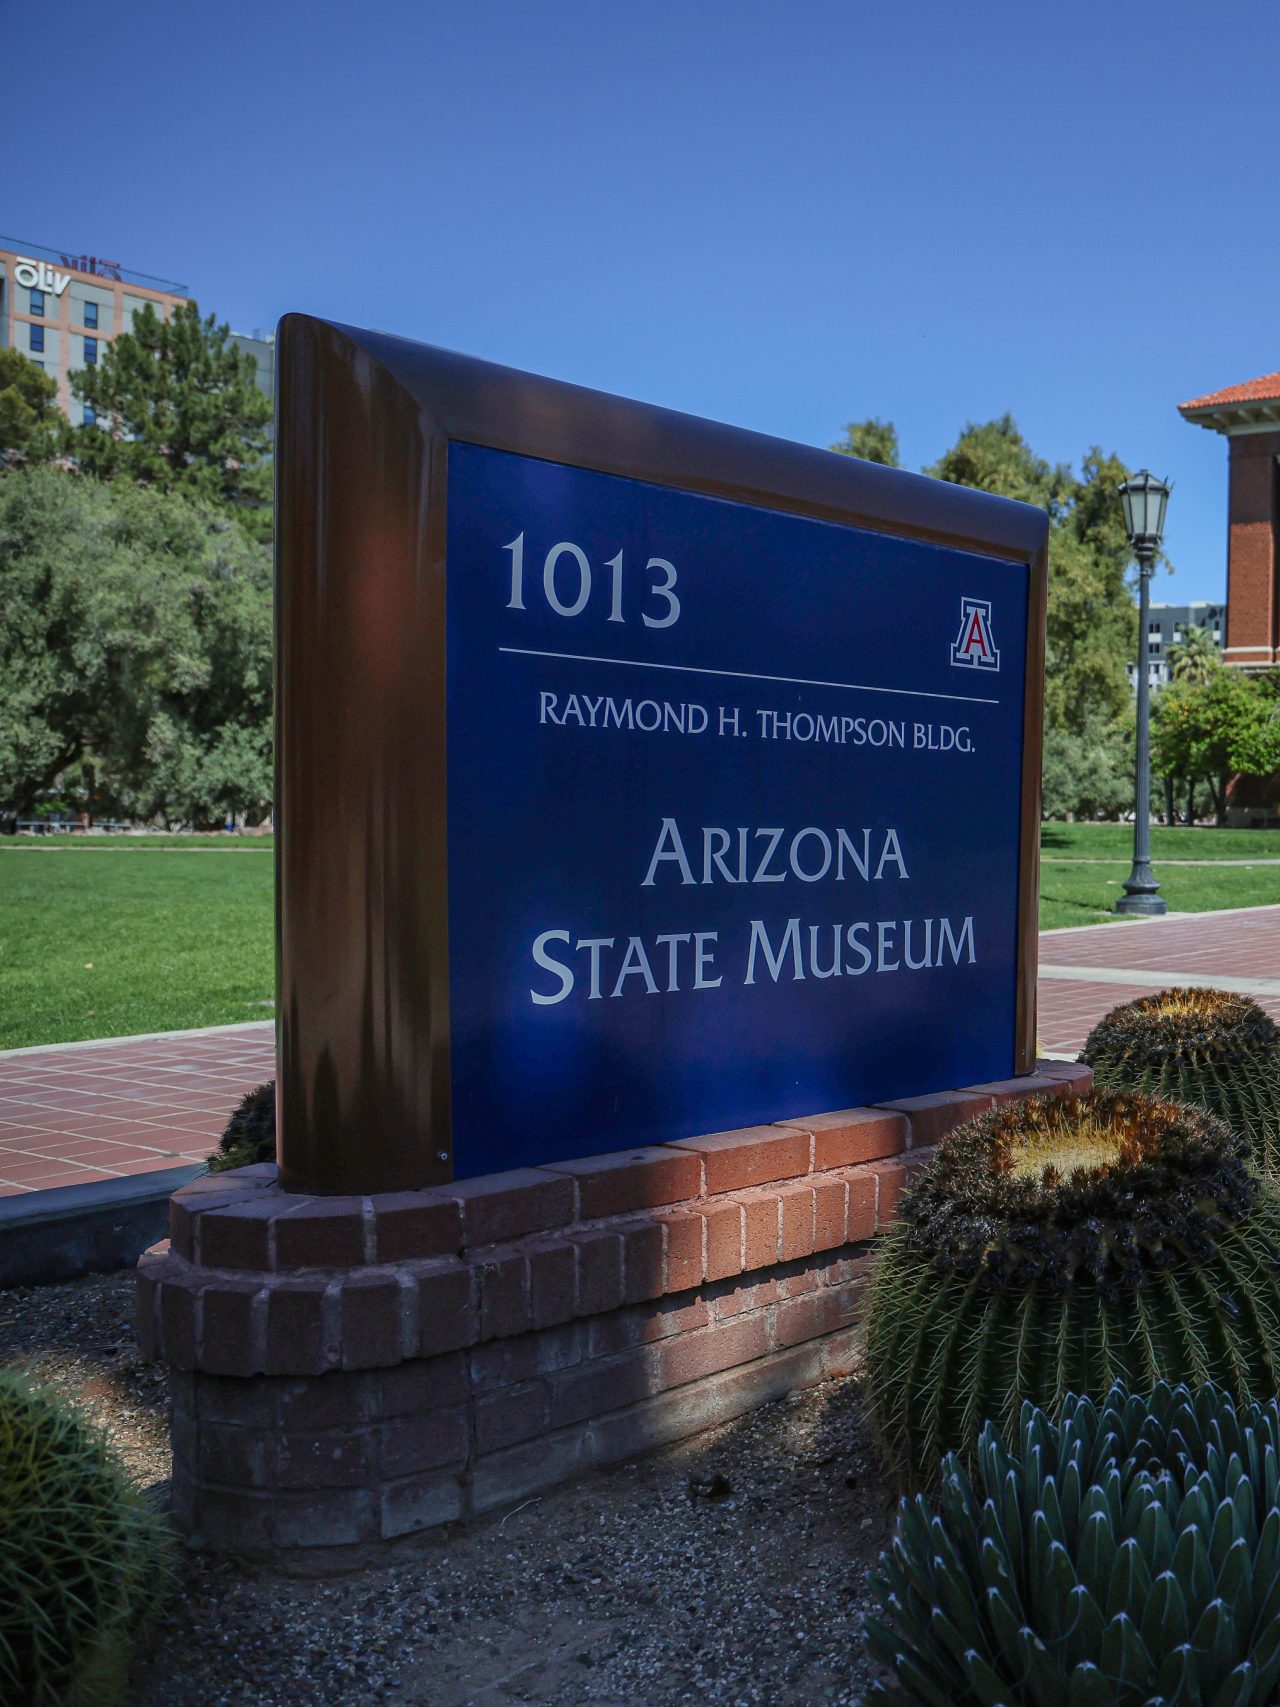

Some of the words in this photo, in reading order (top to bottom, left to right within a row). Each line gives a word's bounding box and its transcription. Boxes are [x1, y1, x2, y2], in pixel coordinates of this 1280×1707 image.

[502, 531, 681, 629] 1013
[950, 596, 1001, 672] A
[539, 691, 708, 734] RAYMOND
[718, 706, 748, 738] H.
[756, 709, 906, 749] THOMPSON
[913, 722, 976, 753] BLDG.
[640, 817, 910, 886] ARIZONA
[530, 929, 724, 1006] STATE
[743, 916, 977, 985] MUSEUM
